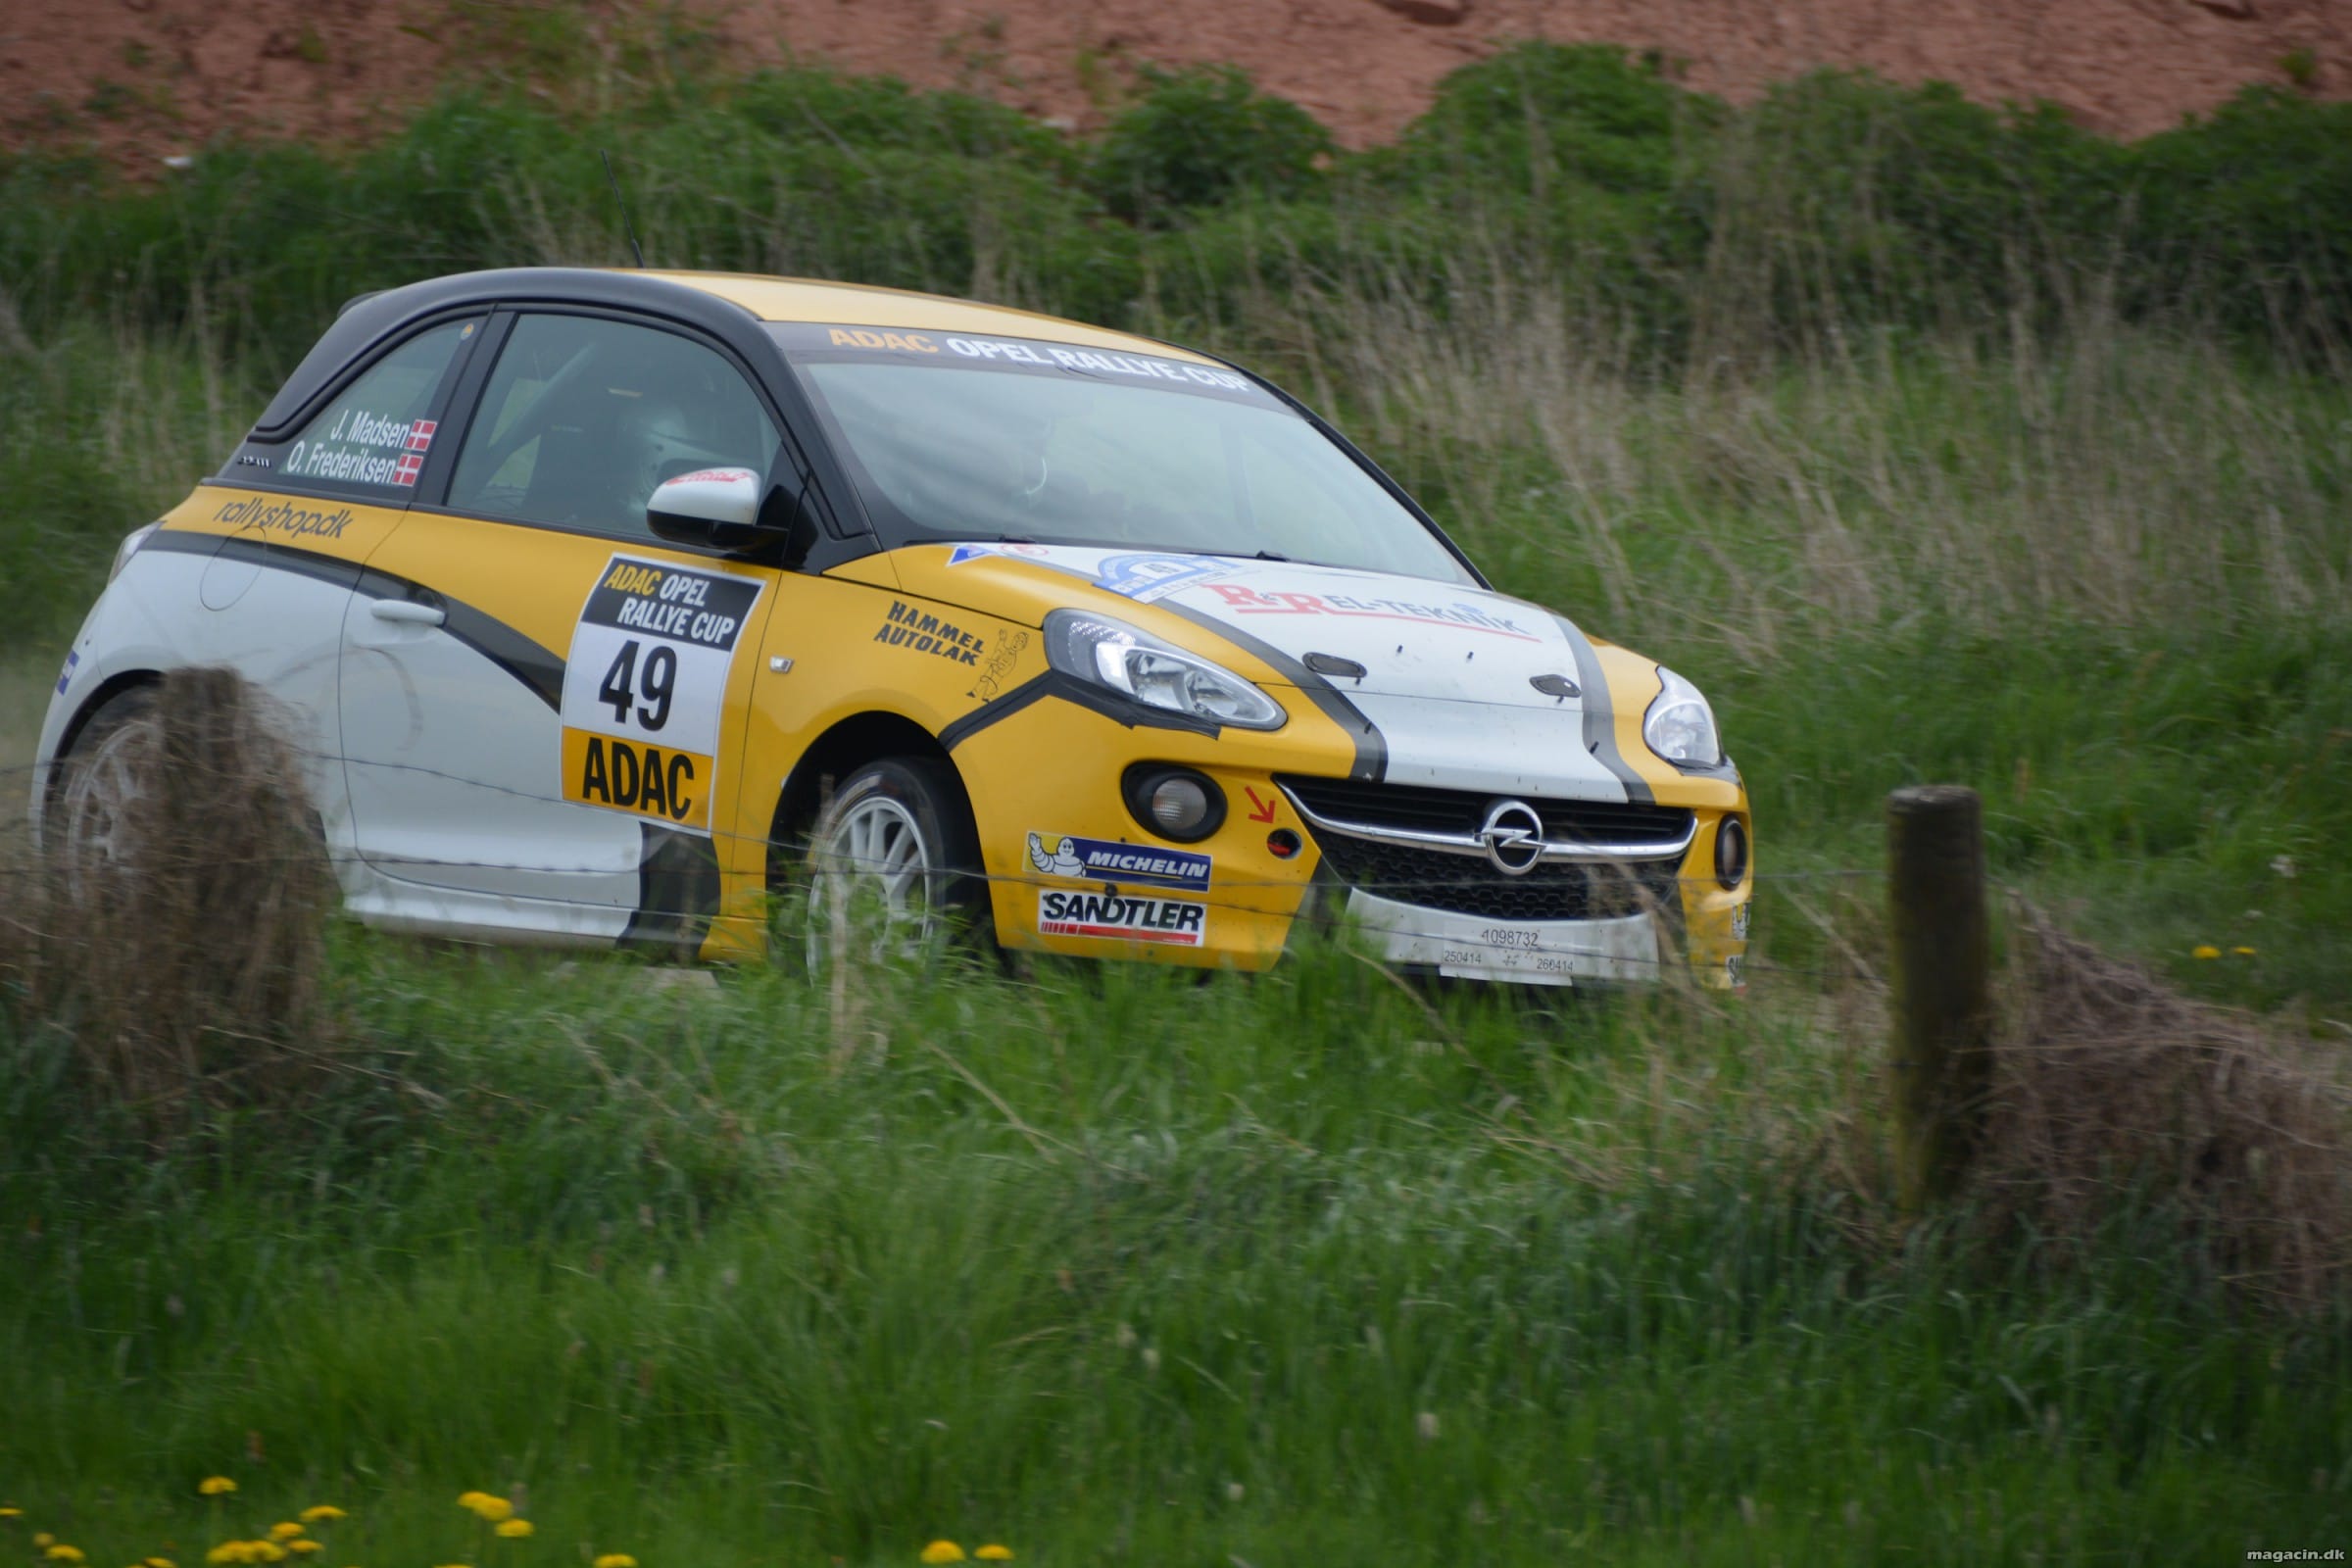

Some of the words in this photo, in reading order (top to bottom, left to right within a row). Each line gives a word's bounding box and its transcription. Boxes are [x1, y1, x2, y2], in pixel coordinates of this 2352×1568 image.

[827, 327, 939, 354] ADAC
[946, 336, 1054, 366] OPEL
[1047, 346, 1187, 381] RALLYE
[1183, 365, 1251, 392] CUP
[329, 409, 349, 441] J.
[346, 410, 411, 450] Madsen
[305, 442, 398, 485] Frederiksen
[604, 563, 662, 597] ADAC
[659, 573, 710, 607] OPEL
[616, 597, 692, 637] RALLYE
[690, 611, 736, 645] CUP
[887, 600, 985, 655] HAMMEL
[873, 622, 980, 667] AUTOLAK
[598, 639, 678, 732] 49
[582, 736, 695, 820] ADAC
[1087, 850, 1208, 878] MICHELIN
[1042, 892, 1204, 932] SANDTLER
[1481, 928, 1540, 948] 1098732
